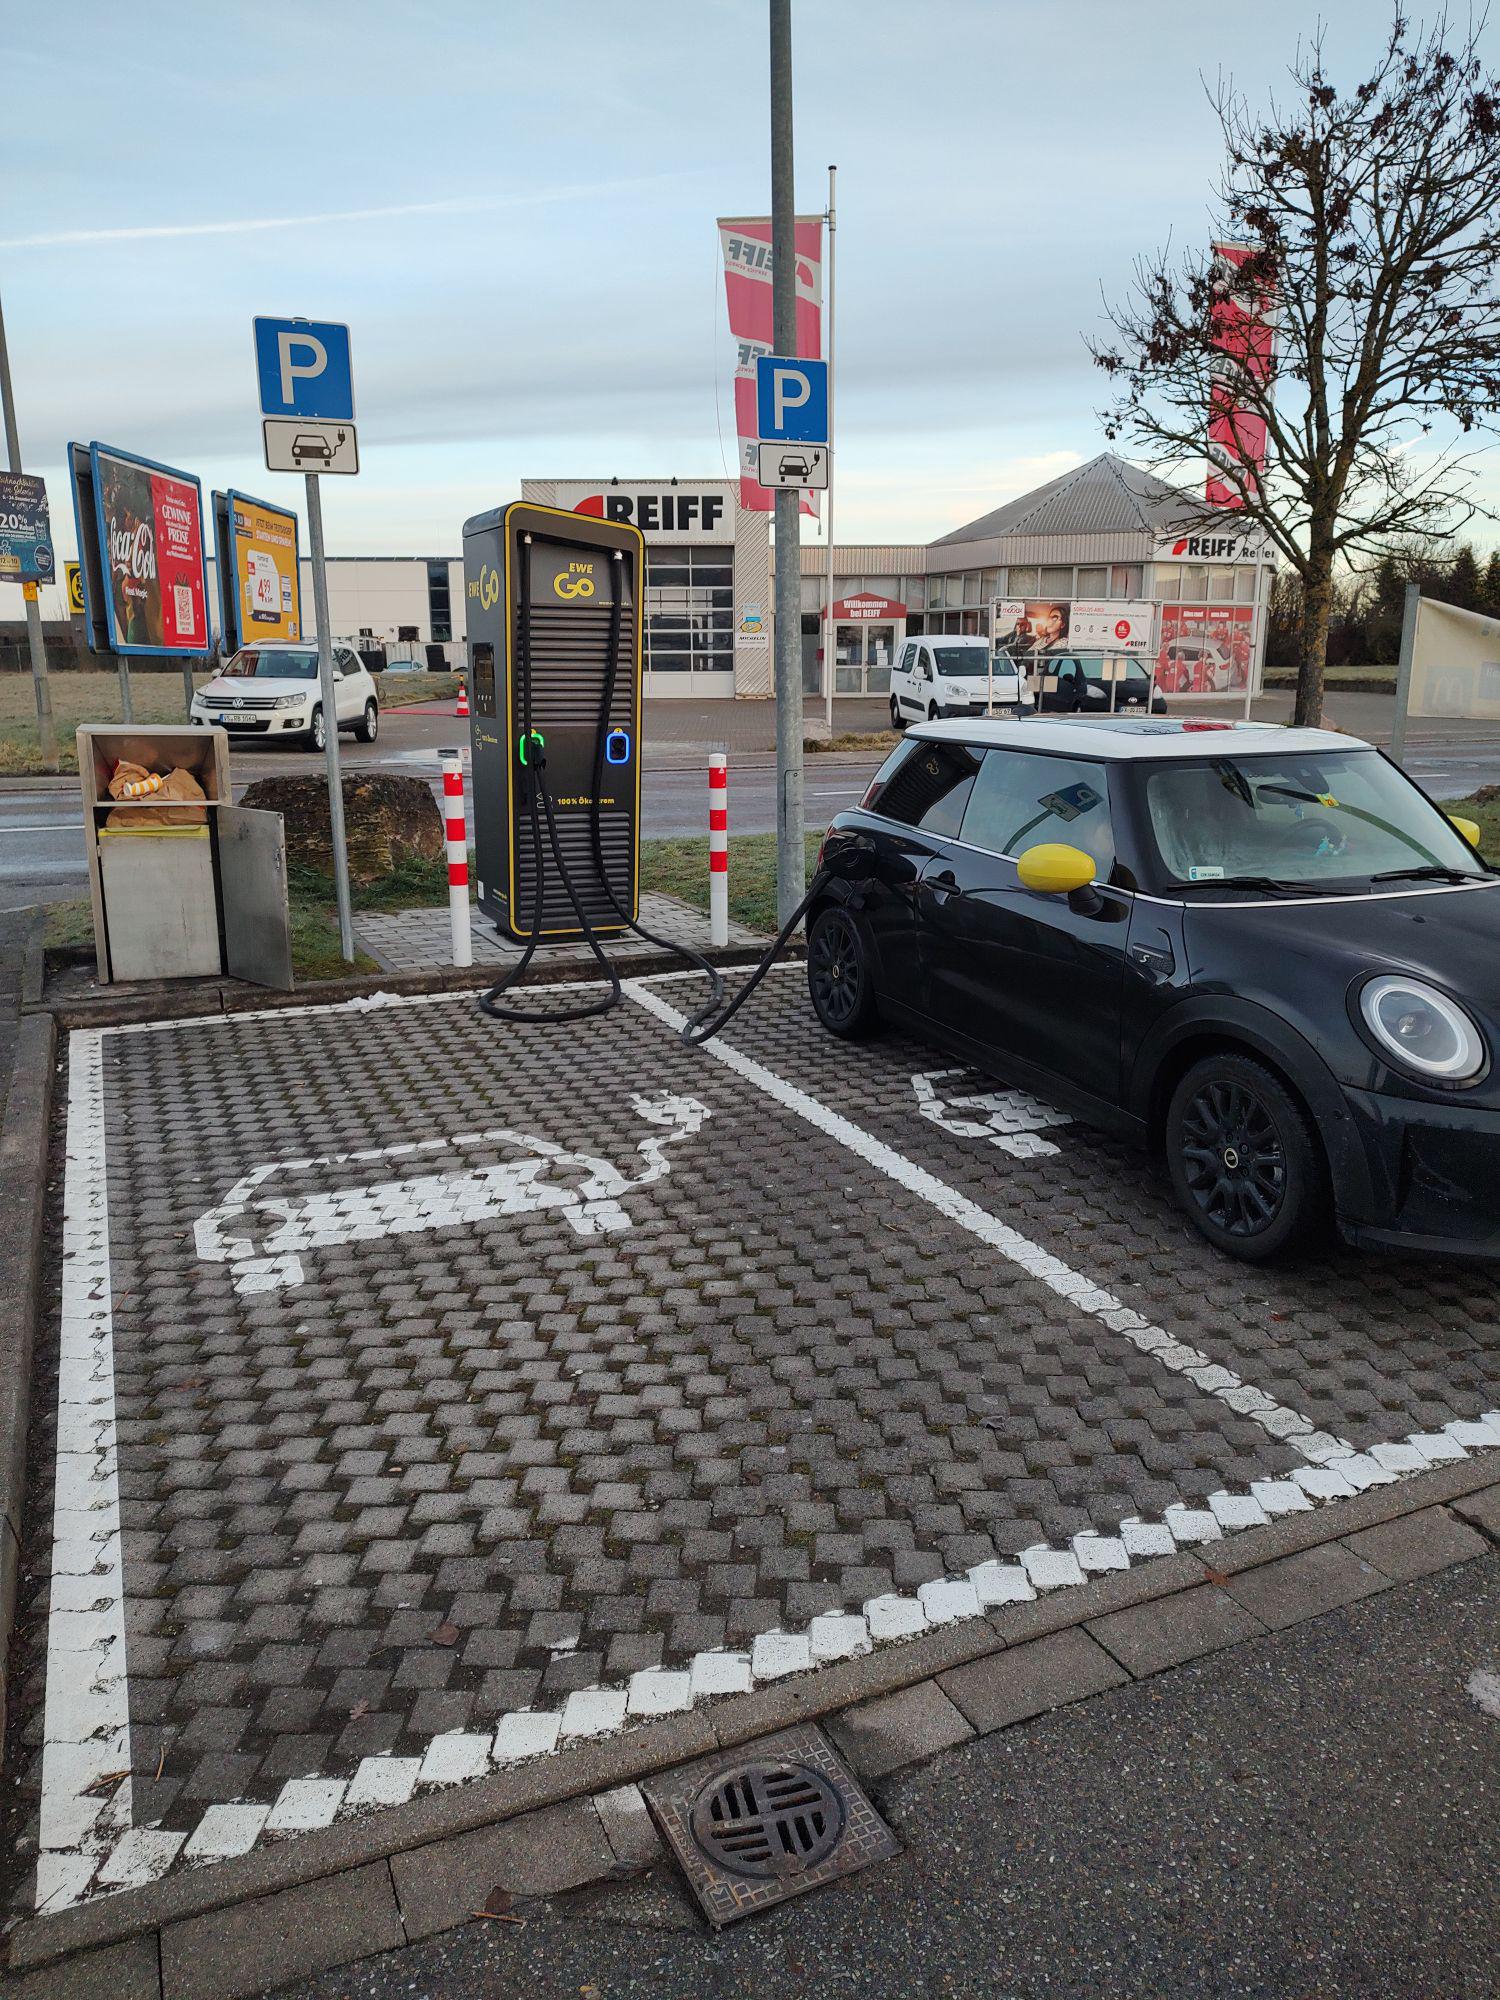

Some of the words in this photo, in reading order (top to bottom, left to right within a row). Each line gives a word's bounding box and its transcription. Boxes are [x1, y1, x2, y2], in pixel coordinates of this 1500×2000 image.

[278, 332, 328, 405] P
[774, 368, 811, 430] P
[607, 496, 724, 531] REIFF
[1188, 538, 1236, 557] REIFF
[569, 562, 593, 574] EWE
[469, 580, 480, 597] EWE
[843, 600, 888, 609] Willkommen
[850, 609, 862, 618] bei
[862, 609, 881, 618] REIFF
[1139, 955, 1150, 963] S
